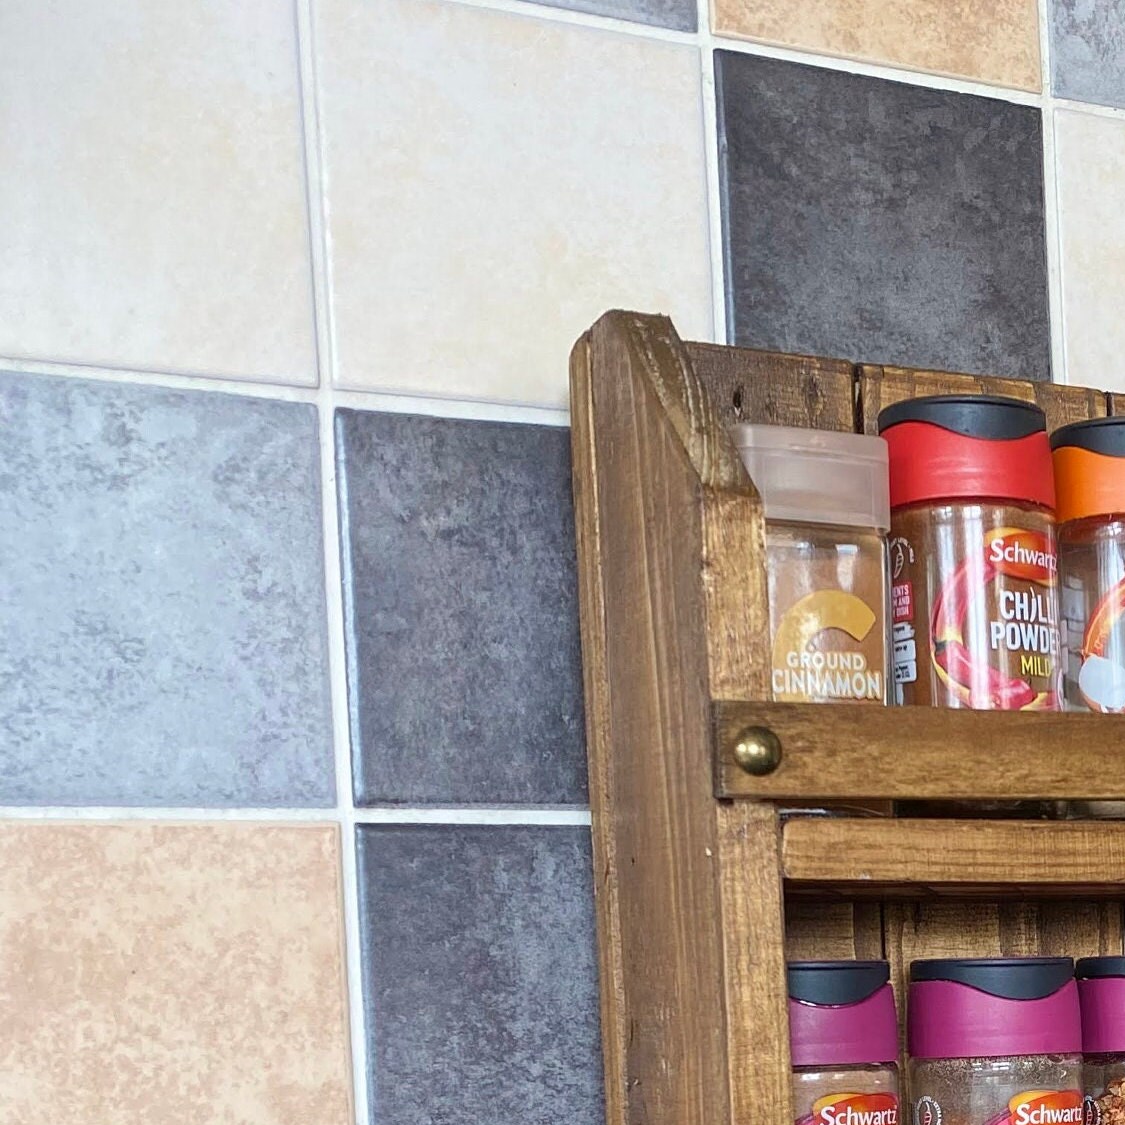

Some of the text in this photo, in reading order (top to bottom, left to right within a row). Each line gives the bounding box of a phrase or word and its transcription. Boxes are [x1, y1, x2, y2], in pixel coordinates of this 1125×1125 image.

[990, 539, 1058, 572] Schwartz
[786, 651, 867, 673] GROUND
[1021, 655, 1051, 677] MILD
[772, 669, 883, 700] CINNAMON
[1015, 1103, 1083, 1125] Schwartz
